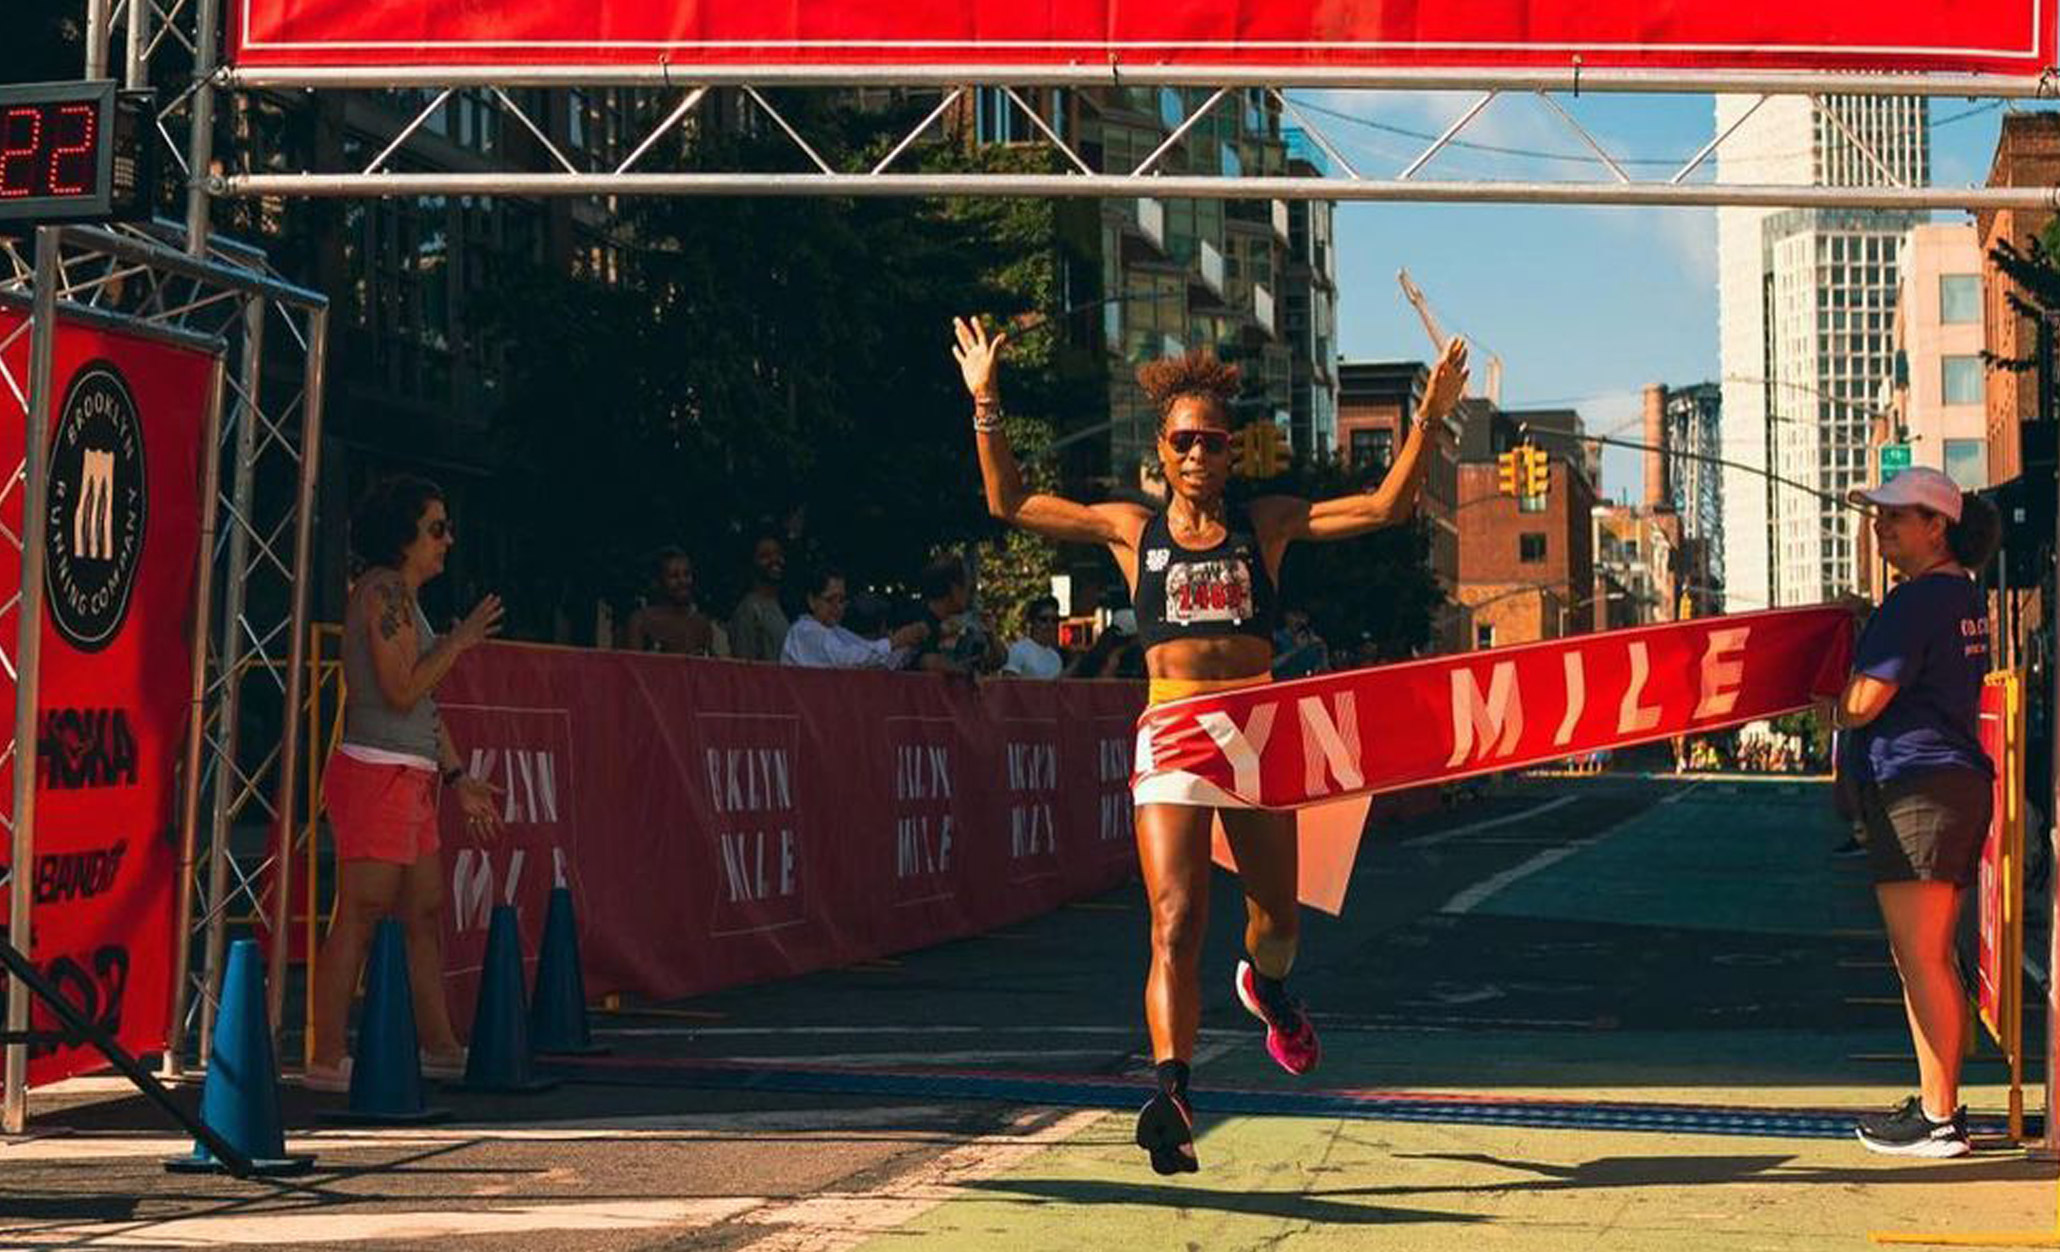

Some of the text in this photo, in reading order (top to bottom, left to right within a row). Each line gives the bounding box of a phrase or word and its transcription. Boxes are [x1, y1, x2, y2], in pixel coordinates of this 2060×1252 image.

[0, 107, 95, 195] 22
[68, 391, 134, 460] BROOKLYN
[51, 480, 138, 617] RUNNING COMPANY
[1446, 627, 1751, 769] MILE
